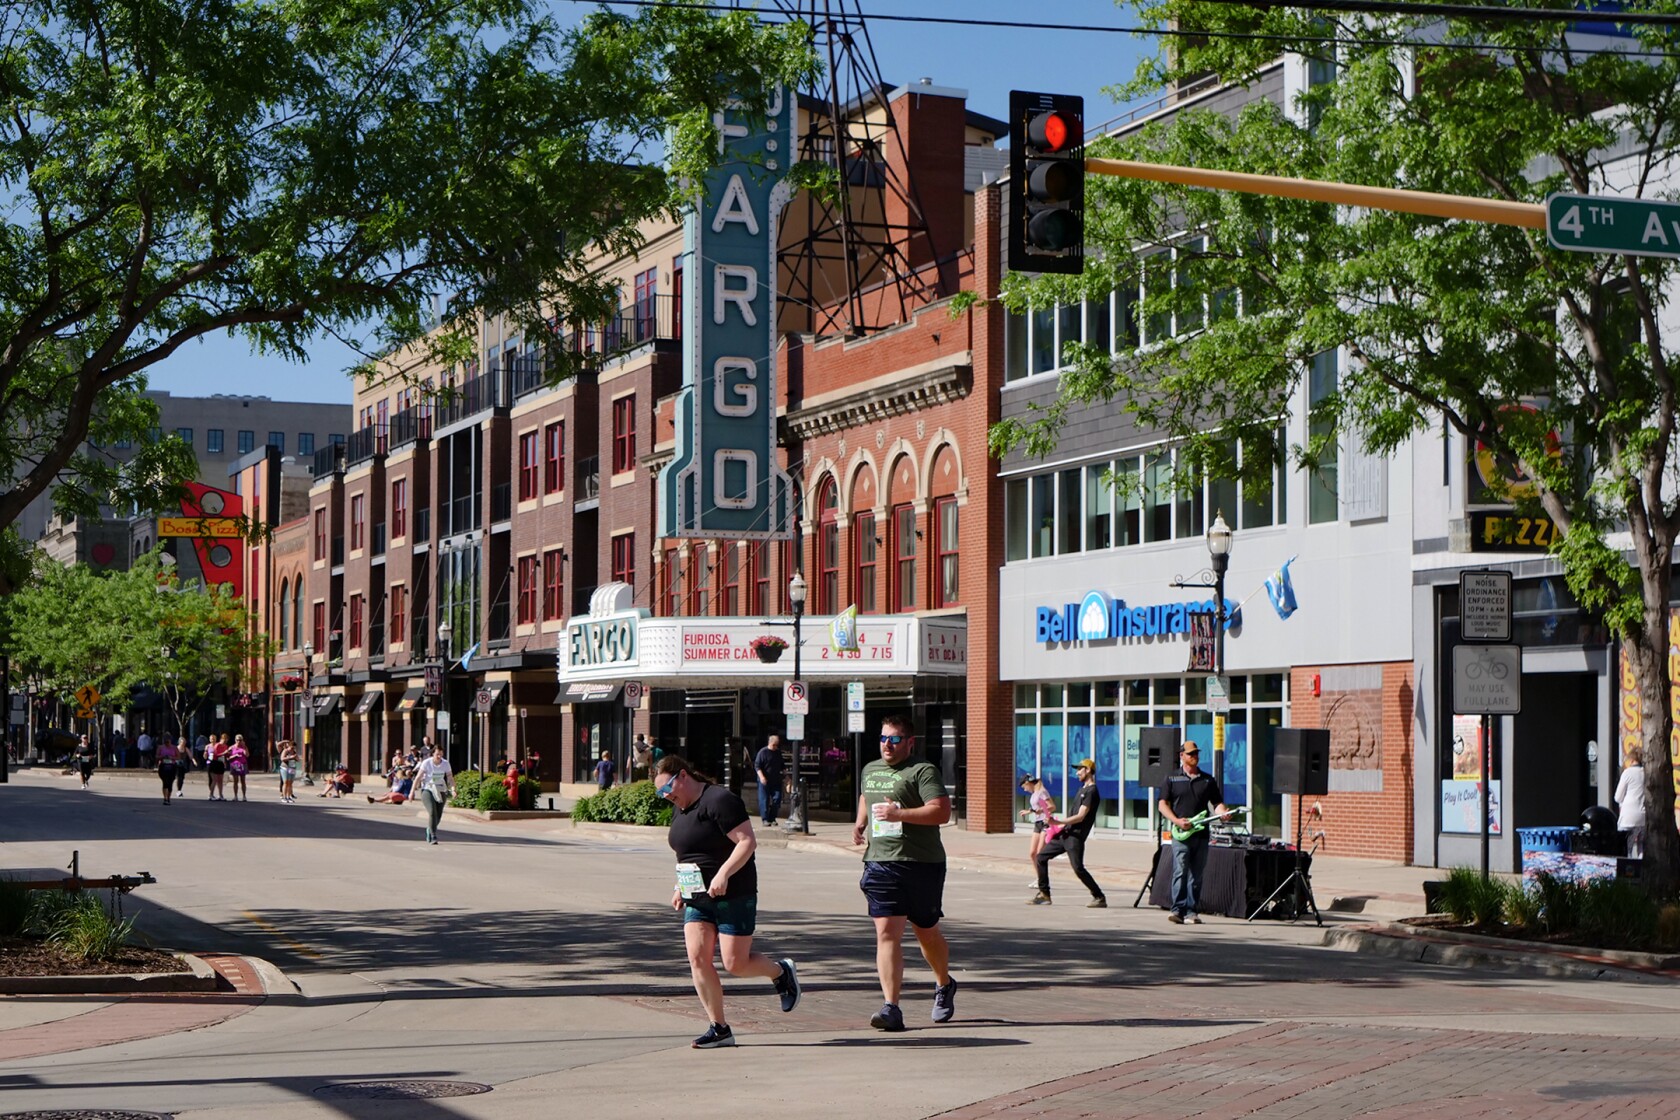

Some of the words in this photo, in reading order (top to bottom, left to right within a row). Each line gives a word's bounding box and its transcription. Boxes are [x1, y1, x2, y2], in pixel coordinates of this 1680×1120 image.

[1557, 205, 1614, 239] 4TH
[711, 98, 759, 509] FARGO
[1466, 588, 1506, 596] ORDINANCE
[1036, 603, 1075, 643] Bell
[569, 620, 633, 667] FARGO
[684, 634, 730, 645] FURIOSA
[858, 633, 865, 644] 4
[887, 633, 893, 644] 7
[684, 648, 730, 660] SUMMER
[734, 648, 760, 660] CAM
[822, 648, 828, 659] 2
[1468, 684, 1486, 692] MAY
[1489, 684, 1505, 692] USE
[1464, 696, 1484, 705] FULL
[1488, 696, 1510, 705] LANE
[1444, 792, 1456, 807] Play
[1457, 790, 1462, 802] It
